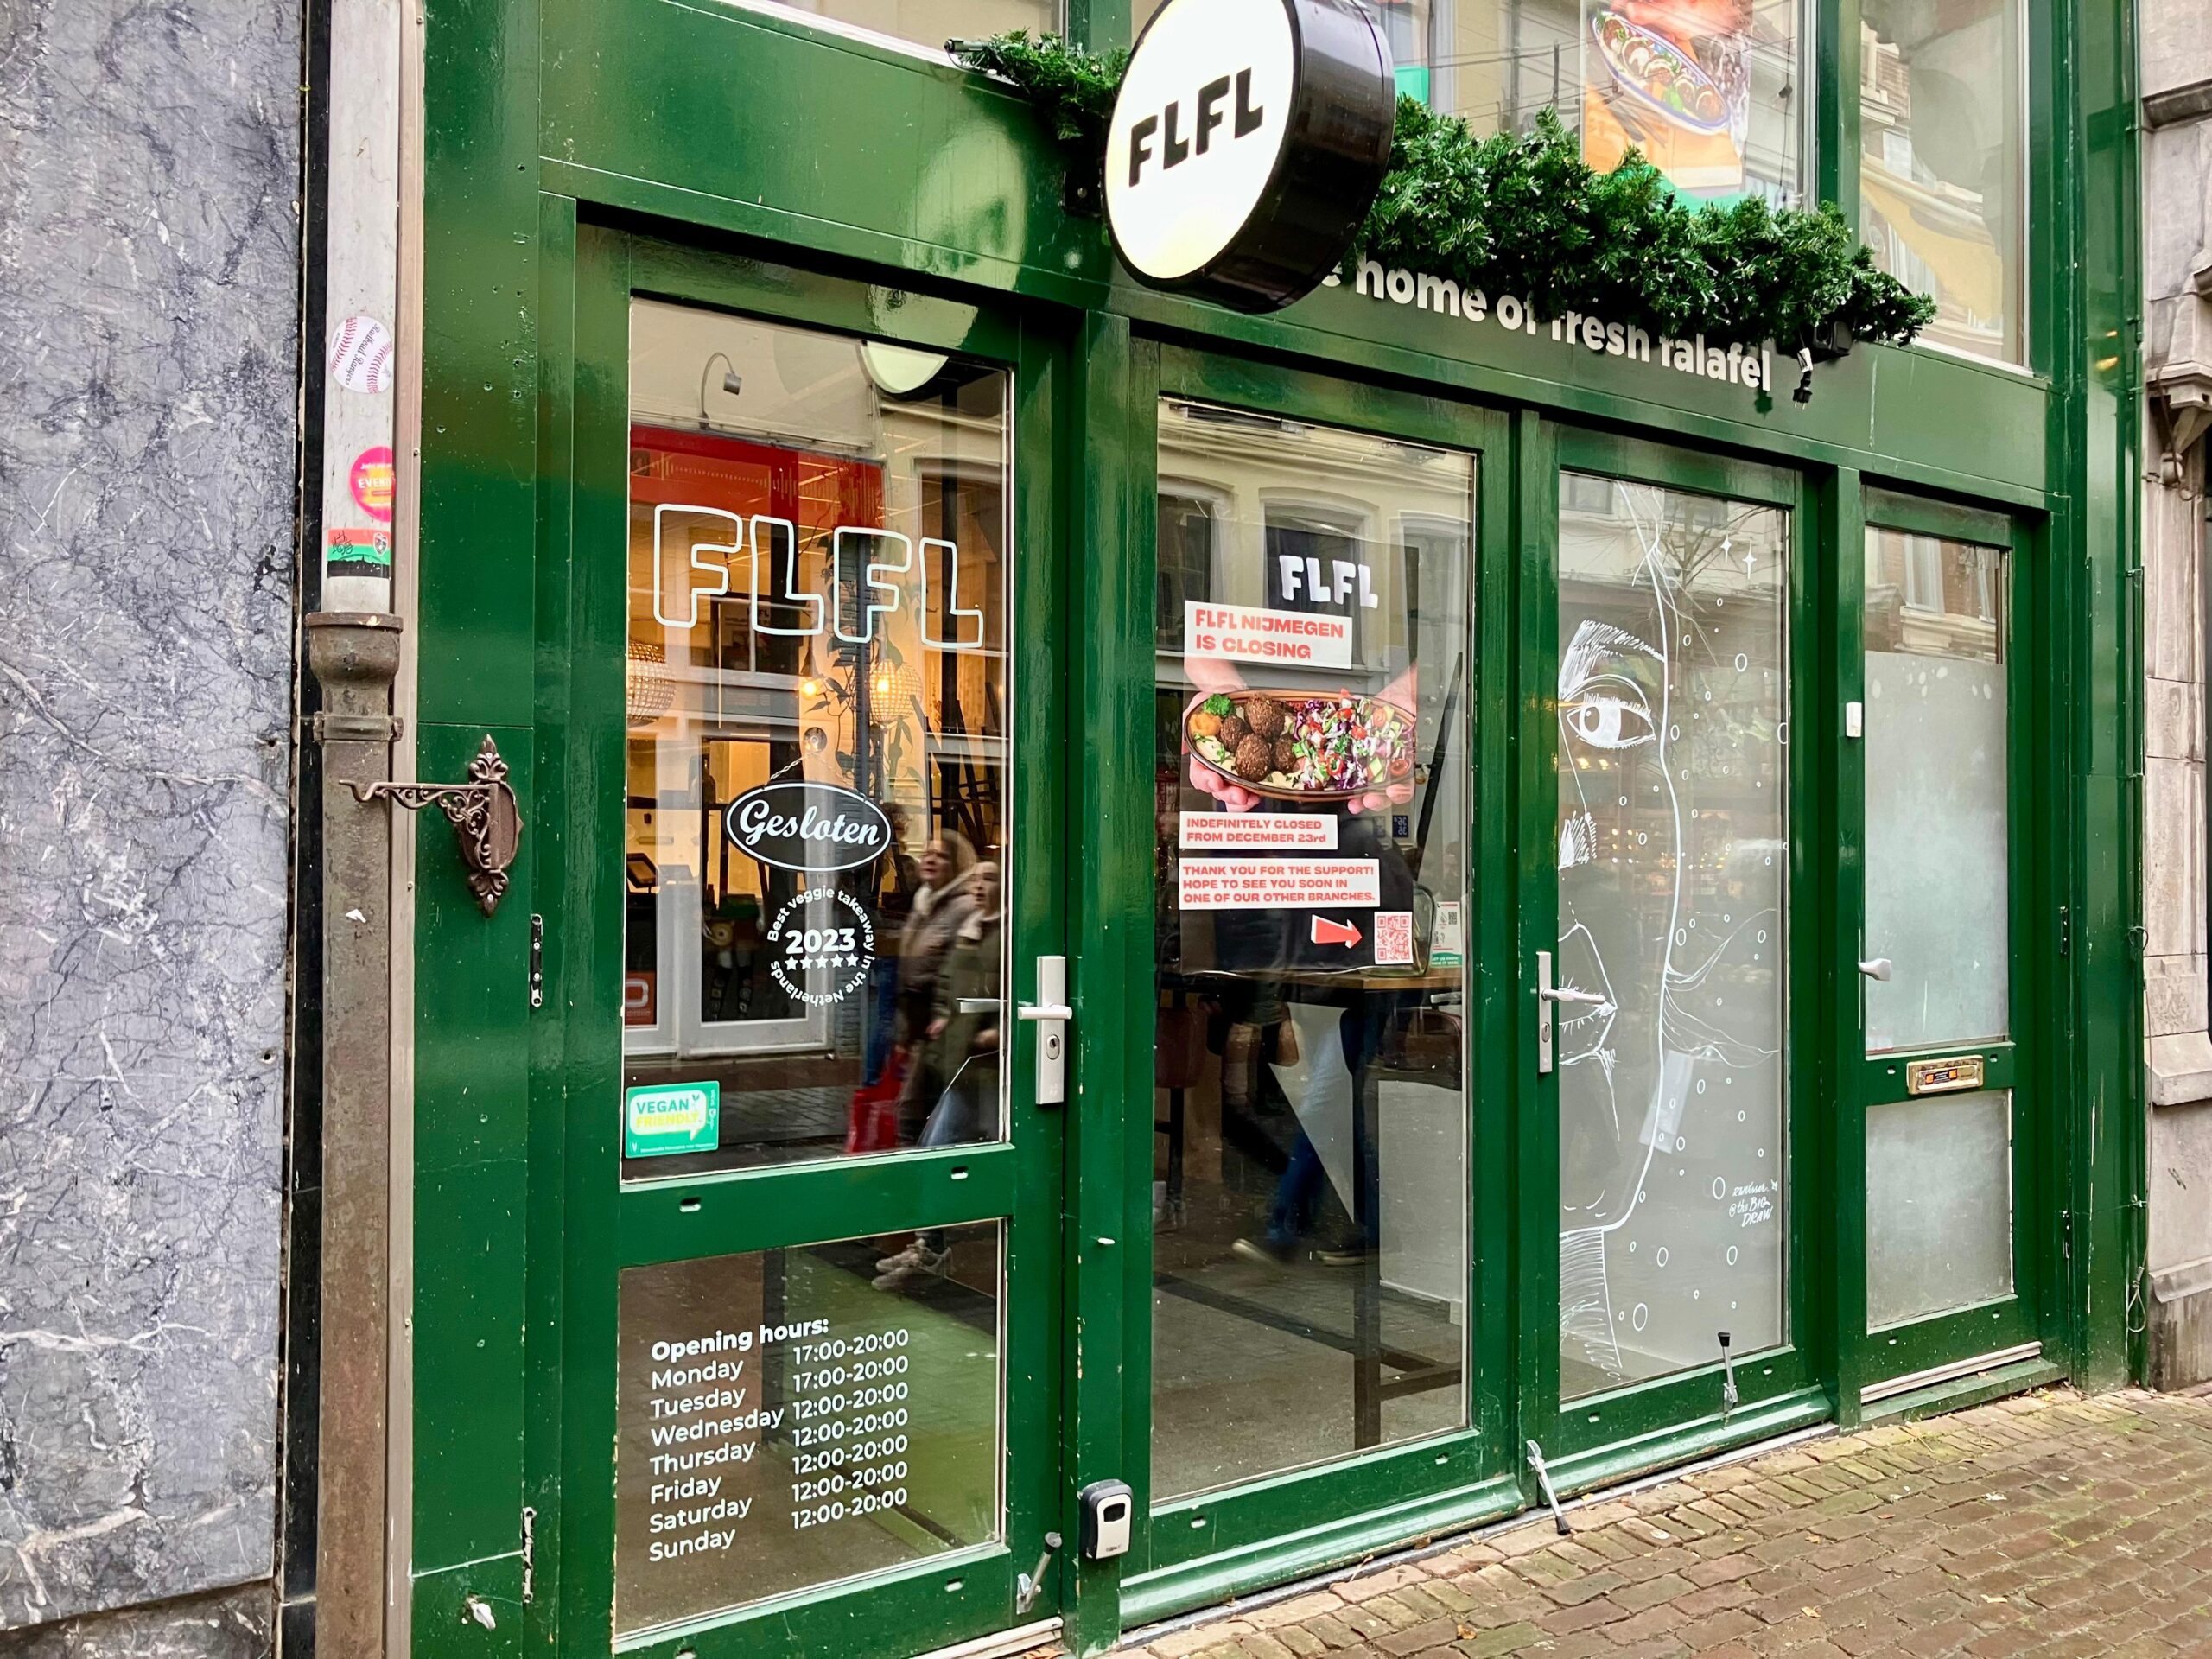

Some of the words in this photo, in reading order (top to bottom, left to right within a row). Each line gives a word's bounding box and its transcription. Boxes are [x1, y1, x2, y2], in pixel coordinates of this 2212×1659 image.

[1128, 67, 1263, 188] FLFL
[1355, 249, 1487, 322] home
[653, 503, 983, 649] FLFL
[1279, 555, 1378, 608] FLFL
[1195, 609, 1238, 629] FLFL
[1241, 611, 1344, 639] NIJMEGEN
[1196, 635, 1216, 650] IS
[1222, 637, 1311, 659] CLOSING
[739, 799, 880, 846] Gesloten
[1186, 832, 1223, 842] FROM
[1226, 833, 1294, 842] DECEMBER
[1297, 834, 1326, 842] 23rd
[1187, 818, 1271, 829] INDEFINITELY
[1274, 820, 1322, 830] CLOSED
[1183, 866, 1226, 875] THANK
[1230, 866, 1256, 875] YOU
[1260, 866, 1285, 875] FOR
[1287, 866, 1311, 874] THE
[1314, 866, 1374, 874] SUPPORT!
[1183, 880, 1217, 889] HOPE
[1221, 880, 1239, 889] TO
[1242, 880, 1267, 888] SEE
[1270, 879, 1296, 888] YOU
[1299, 879, 1332, 888] SOON
[1336, 879, 1348, 888] IN
[787, 885, 835, 909] veggie
[1183, 893, 1211, 903] ONE
[1214, 893, 1230, 902] OF
[1233, 893, 1260, 902] OUR
[1263, 893, 1305, 902] OTHER
[1308, 892, 1376, 901] BRANCHES.
[766, 907, 790, 942] Best
[785, 928, 855, 955] 2023
[837, 889, 876, 952] takeaway
[770, 960, 845, 1007] Netherlands
[846, 972, 867, 994] the
[861, 955, 876, 969] in
[635, 1111, 700, 1128] FRIENDLY
[636, 1098, 690, 1115] VEGAN
[651, 1329, 753, 1363] Opening
[760, 1318, 830, 1344] hours:
[652, 1359, 744, 1390] Monday
[792, 1328, 909, 1365] 17:00-20:00
[650, 1388, 747, 1418] Tuesday
[792, 1355, 909, 1393] 17:00-20:00
[651, 1408, 785, 1446] Wednesday
[792, 1382, 908, 1420] 12:00-20:00
[649, 1441, 757, 1476] Thursday
[792, 1408, 908, 1447] 12:00-20:00
[650, 1476, 722, 1504] Friday
[791, 1434, 908, 1475] 12:00-20:00
[649, 1497, 753, 1533] Saturday
[791, 1460, 908, 1503] 12:00-20:00
[649, 1529, 736, 1562] Sunday
[791, 1487, 907, 1529] 12:00-20:00
